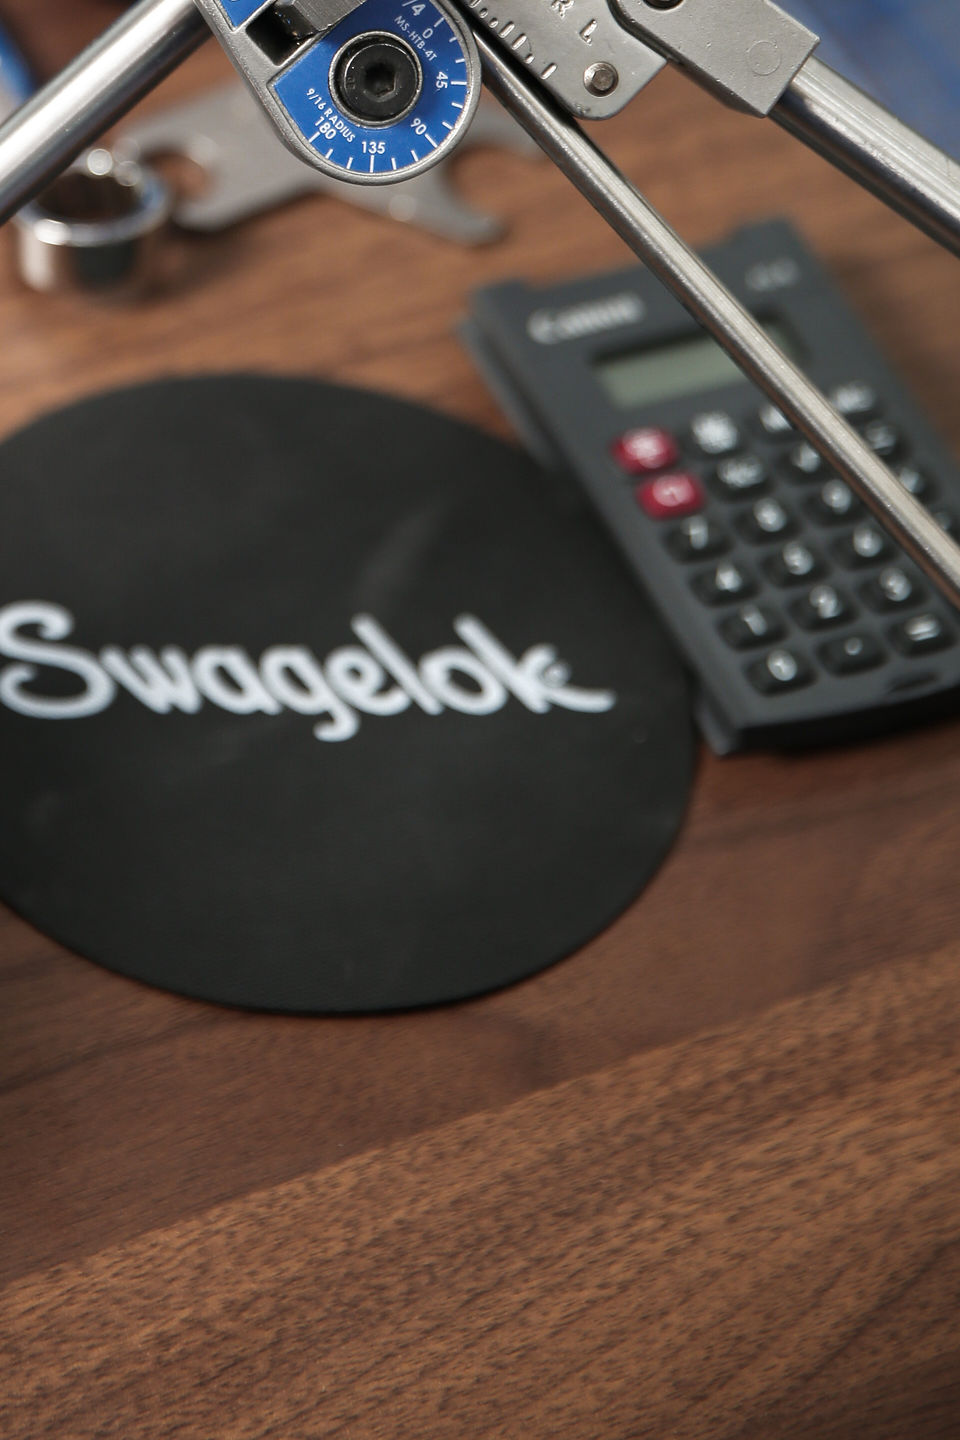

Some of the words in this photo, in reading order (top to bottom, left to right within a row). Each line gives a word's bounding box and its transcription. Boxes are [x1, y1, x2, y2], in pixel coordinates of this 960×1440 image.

[393, 15, 438, 62] MS-HTB-4T
[422, 27, 434, 40] 0
[435, 71, 449, 89] 45
[306, 88, 327, 110] 9/16
[323, 108, 356, 143] RADIUS
[314, 116, 337, 140] 180
[410, 117, 427, 136] 90
[361, 140, 386, 155] 135
